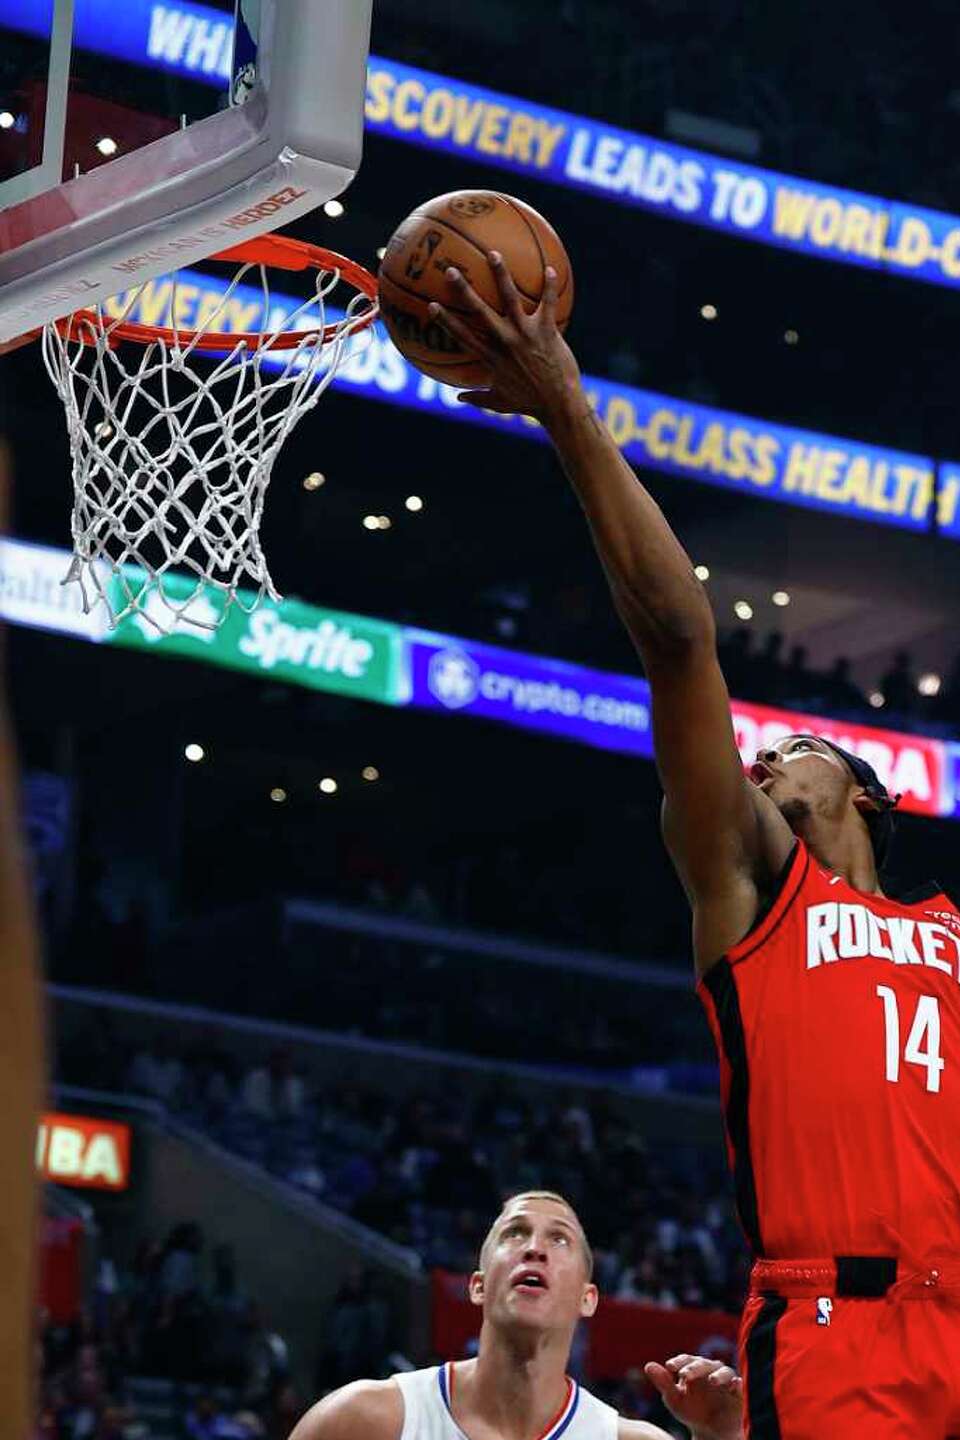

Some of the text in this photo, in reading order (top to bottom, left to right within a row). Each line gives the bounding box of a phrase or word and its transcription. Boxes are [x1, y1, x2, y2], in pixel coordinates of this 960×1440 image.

[365, 69, 565, 168] SCOVERY
[564, 128, 706, 213] LEADS
[711, 169, 767, 228] TO
[586, 392, 778, 487] D-CLASS
[781, 440, 960, 527] HEALTH
[239, 608, 373, 678] Sprite
[480, 670, 650, 733] crypto.com
[875, 984, 944, 1093] 14
[34, 1124, 123, 1185] BA
